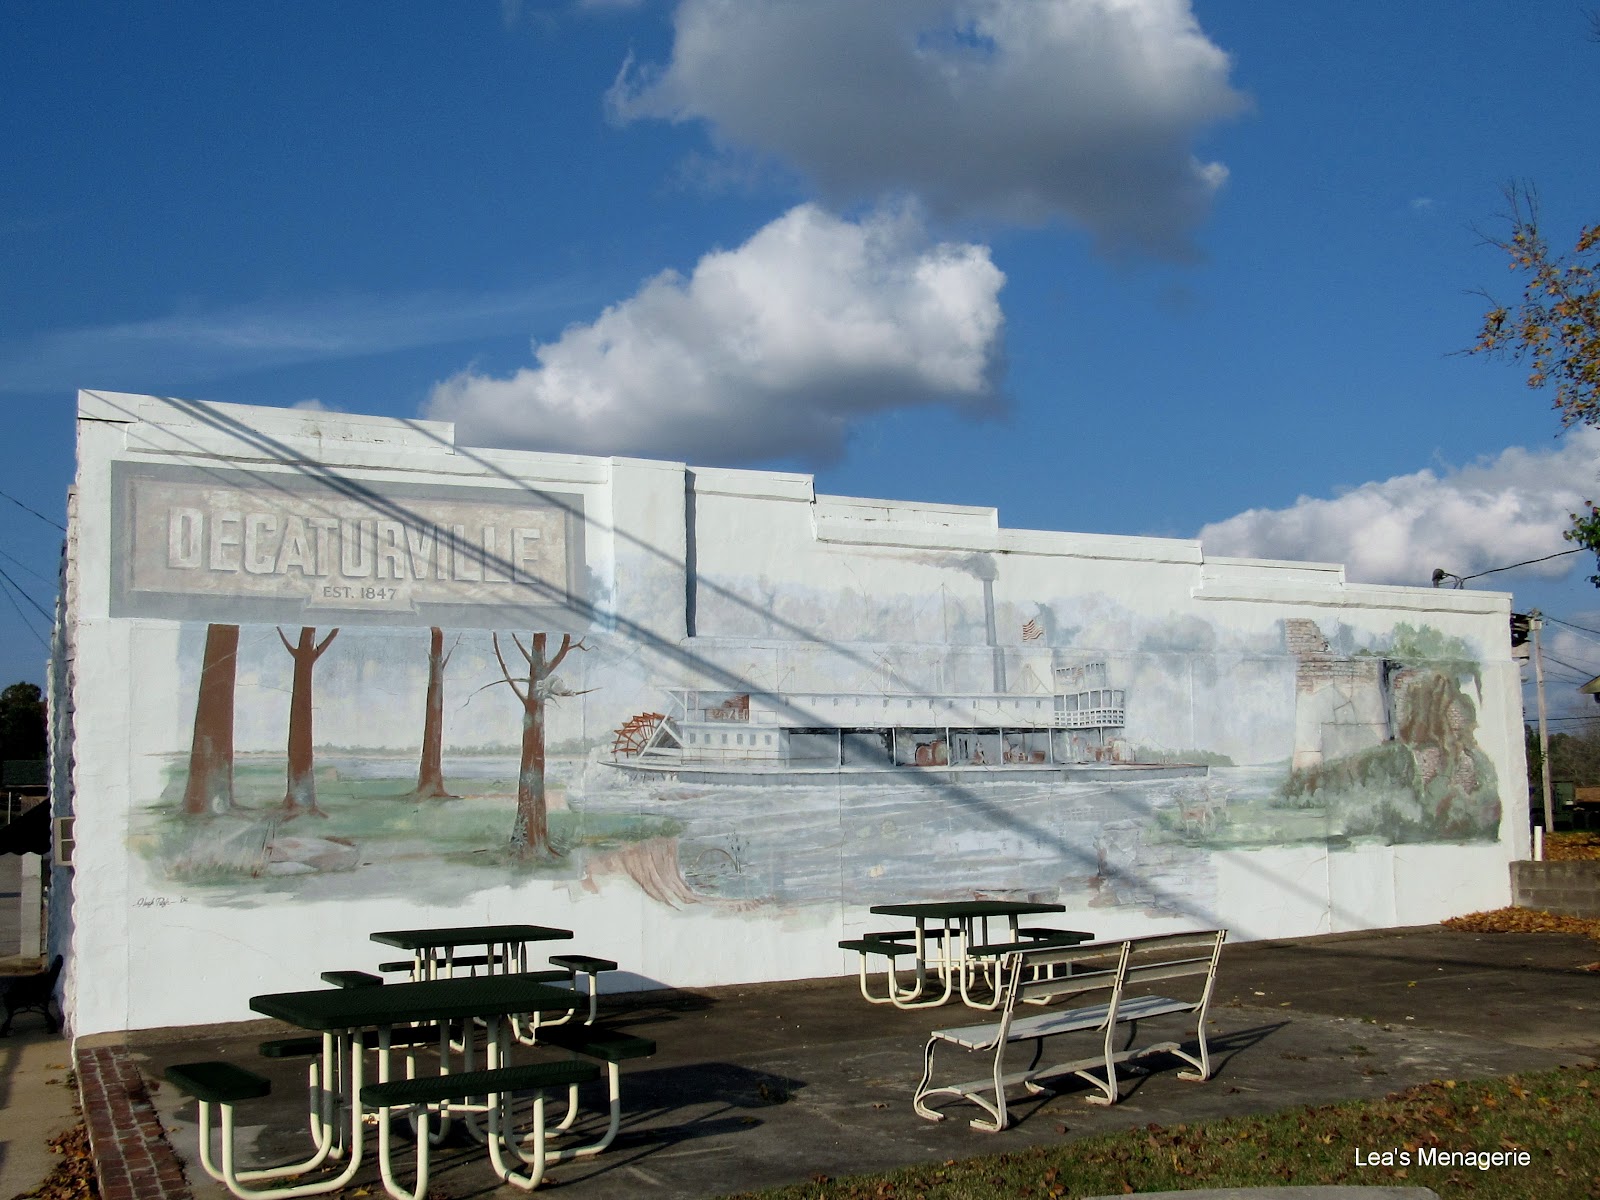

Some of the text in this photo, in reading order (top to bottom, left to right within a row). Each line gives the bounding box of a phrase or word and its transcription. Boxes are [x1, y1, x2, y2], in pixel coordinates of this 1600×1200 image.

[168, 507, 541, 584] DECATURVILLE
[323, 586, 397, 600] EST. 1847
